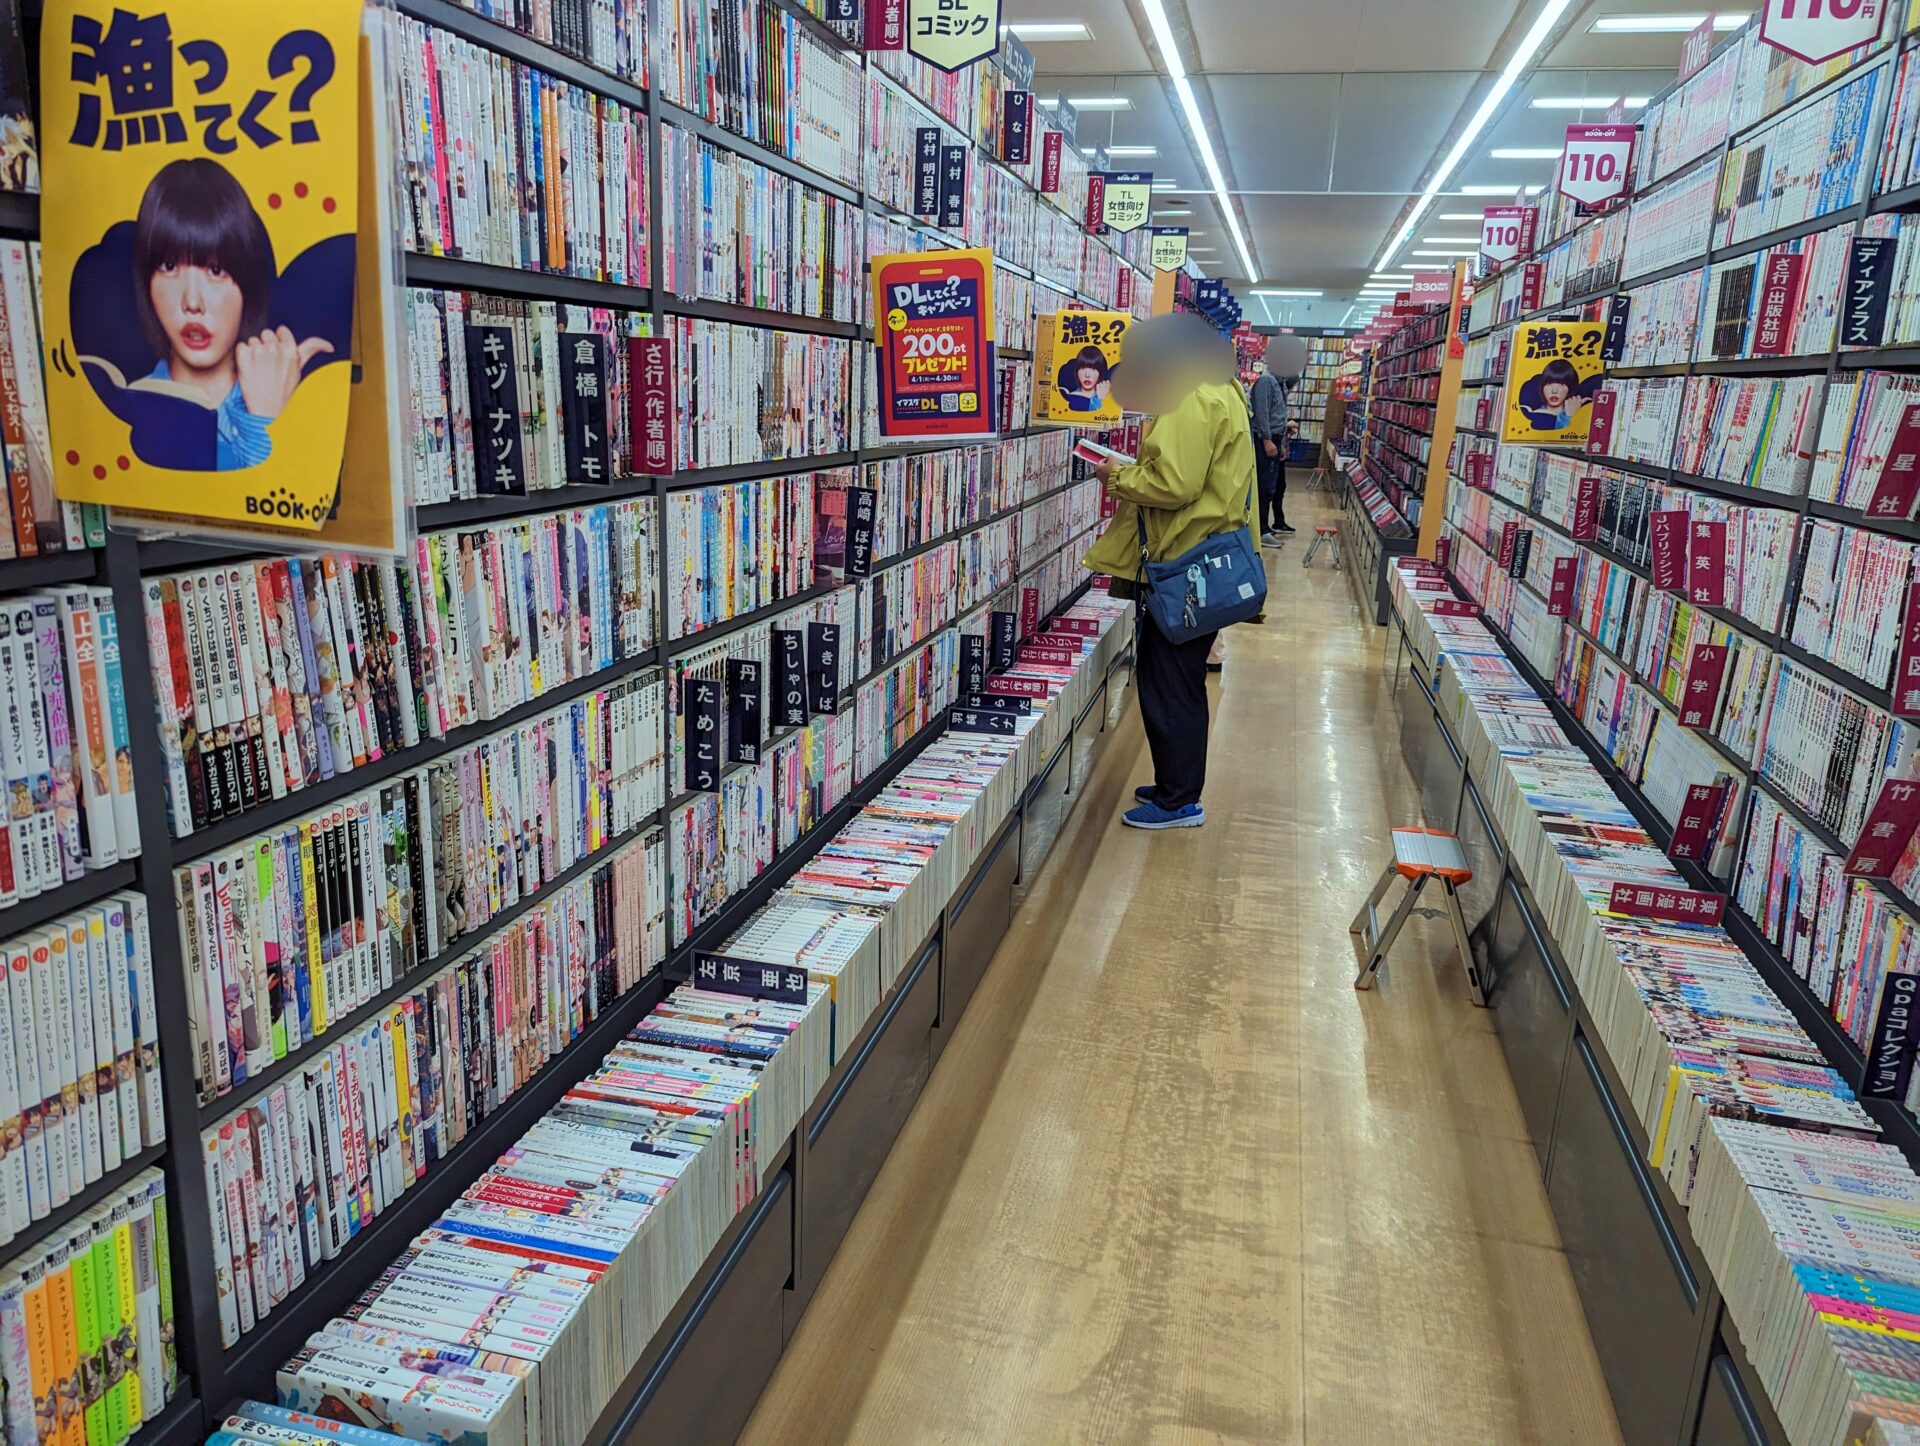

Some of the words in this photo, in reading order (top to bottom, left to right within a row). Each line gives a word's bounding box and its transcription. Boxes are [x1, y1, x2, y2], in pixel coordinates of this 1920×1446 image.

[917, 15, 990, 36] コミック
[923, 131, 937, 157] 中村
[1010, 94, 1024, 160] ひなこ
[921, 162, 936, 213] 明日美子
[948, 150, 962, 180] 中村
[1570, 154, 1616, 182] 110
[1091, 179, 1101, 225] ハーレクイン
[1108, 201, 1145, 211] 女性向け
[1109, 212, 1142, 221] コミック
[1121, 191, 1134, 200] TL
[1155, 248, 1182, 256] 女性向け
[1486, 227, 1519, 246] 110
[917, 296, 971, 316] キャンペーン
[1759, 258, 1791, 349] さ行(出版社別)
[1849, 247, 1879, 342] ディアプラス
[1603, 298, 1627, 358] フロース
[482, 333, 508, 390] キヅ
[574, 339, 598, 398] 倉橋
[644, 343, 666, 468] さ行(作者順)
[921, 397, 939, 410] DL
[1591, 393, 1609, 453] 幻冬舎
[489, 407, 516, 490] ナツキ
[580, 424, 602, 479] トモ
[17, 475, 35, 534] ウノハナ
[1576, 480, 1593, 537] コアマガジン
[1655, 514, 1675, 587] Jパブリッシング
[1694, 523, 1712, 602] 集英社
[233, 588, 249, 646] 王様の休日
[1003, 614, 1014, 642] ヨネダ
[970, 637, 982, 658] 山本
[1002, 648, 1011, 666] コウ
[1033, 637, 1081, 646] アンソロジー
[739, 664, 756, 711] 丹下
[783, 633, 804, 724] ちしゃの実
[818, 626, 833, 711] ときしば
[970, 665, 982, 692] 小鉄子
[990, 680, 1046, 694] ら行(作者順)
[1683, 648, 1715, 726] 小学館
[970, 696, 1030, 711] はらだ
[989, 717, 1015, 730] ハナ
[37, 749, 45, 759] 2
[696, 683, 715, 788] ためこう
[739, 743, 756, 762] 道
[205, 754, 222, 811] サガミワカ
[222, 748, 238, 804] サガミワカ
[239, 743, 255, 797] サガミワカ
[254, 737, 269, 791] サガミワカ
[350, 821, 359, 857] コヨーテ
[1674, 786, 1713, 857] 祥伝社
[1852, 783, 1917, 873] 竹書房
[315, 837, 325, 877] コヨーテ
[327, 834, 336, 868] コヨーテ
[337, 828, 346, 863] コヨーテ
[1613, 886, 1719, 918] 東京漫画社
[699, 960, 741, 983] 左京
[760, 968, 805, 993] 亜也
[1871, 977, 1917, 1094] Qpaコレクション
